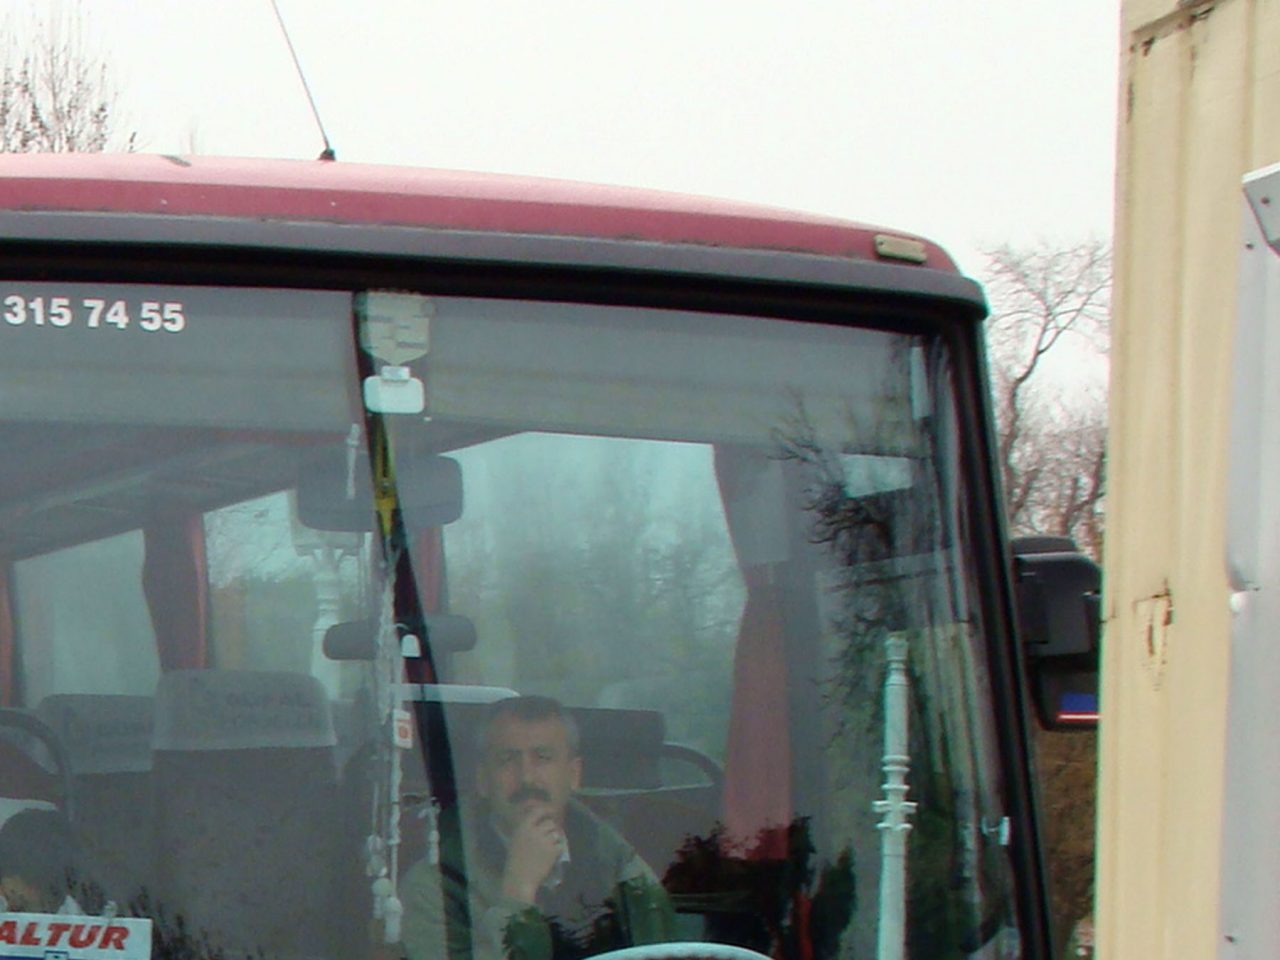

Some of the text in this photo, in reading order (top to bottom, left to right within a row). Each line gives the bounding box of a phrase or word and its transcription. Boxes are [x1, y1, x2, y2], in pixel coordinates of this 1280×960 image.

[4, 295, 72, 327] 315
[83, 299, 129, 329] 74
[140, 301, 186, 332] 55
